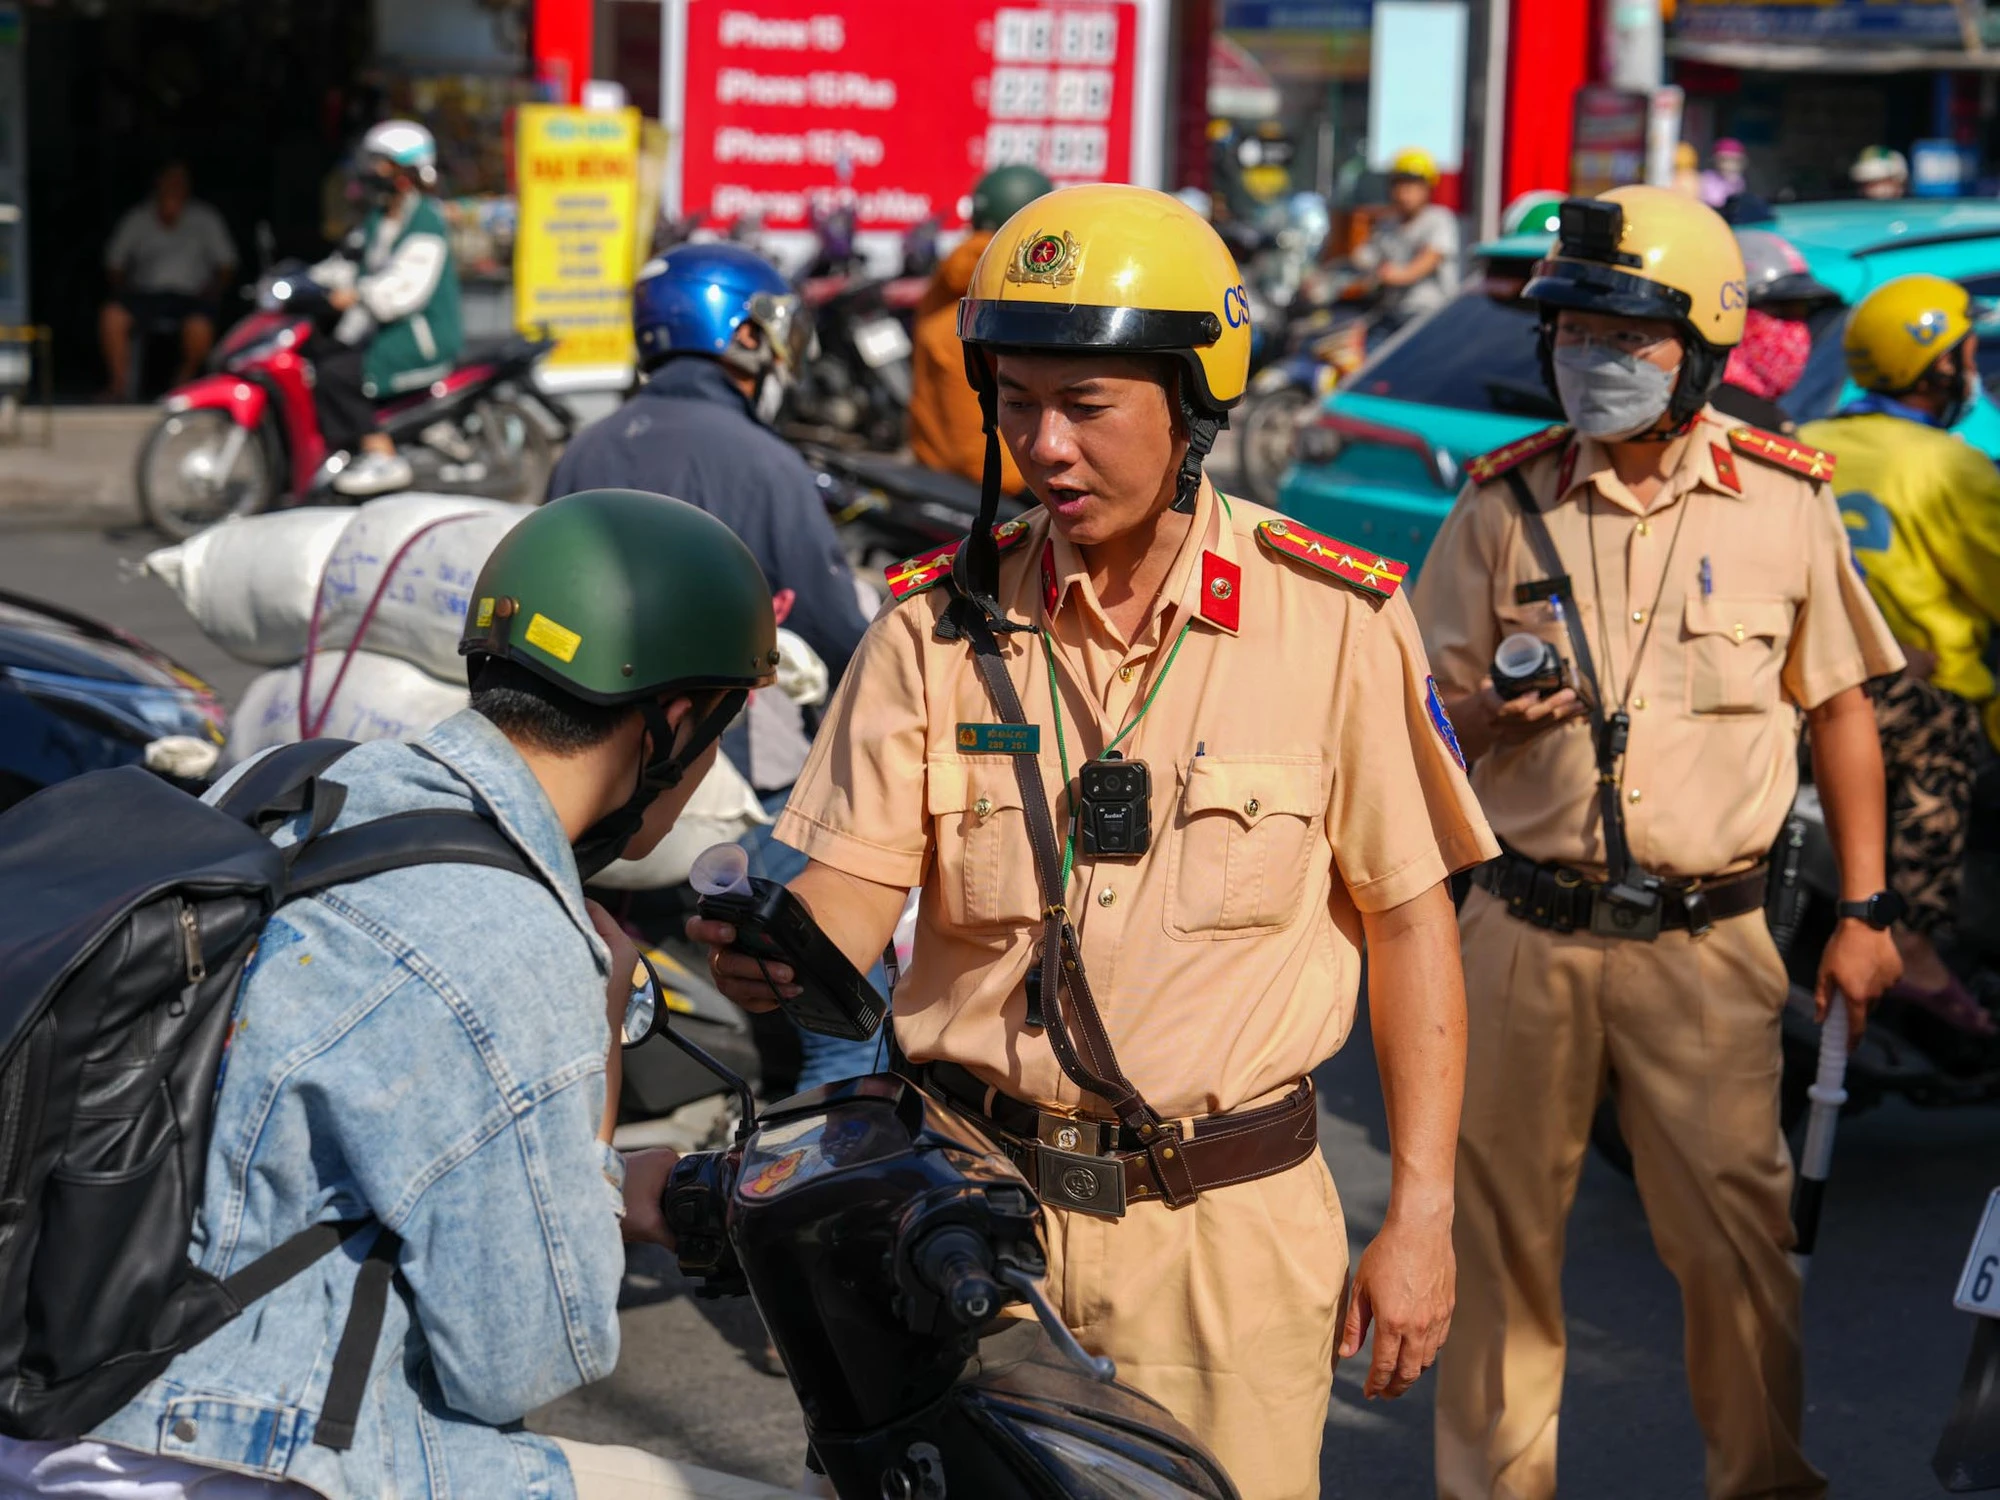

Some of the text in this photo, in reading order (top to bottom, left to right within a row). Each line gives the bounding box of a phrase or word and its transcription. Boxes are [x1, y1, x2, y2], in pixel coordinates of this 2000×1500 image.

[718, 10, 807, 50] iPhone
[716, 66, 806, 107] iPhone
[842, 71, 897, 111] Plus
[713, 126, 803, 165] iPhone
[837, 129, 885, 167] Pro
